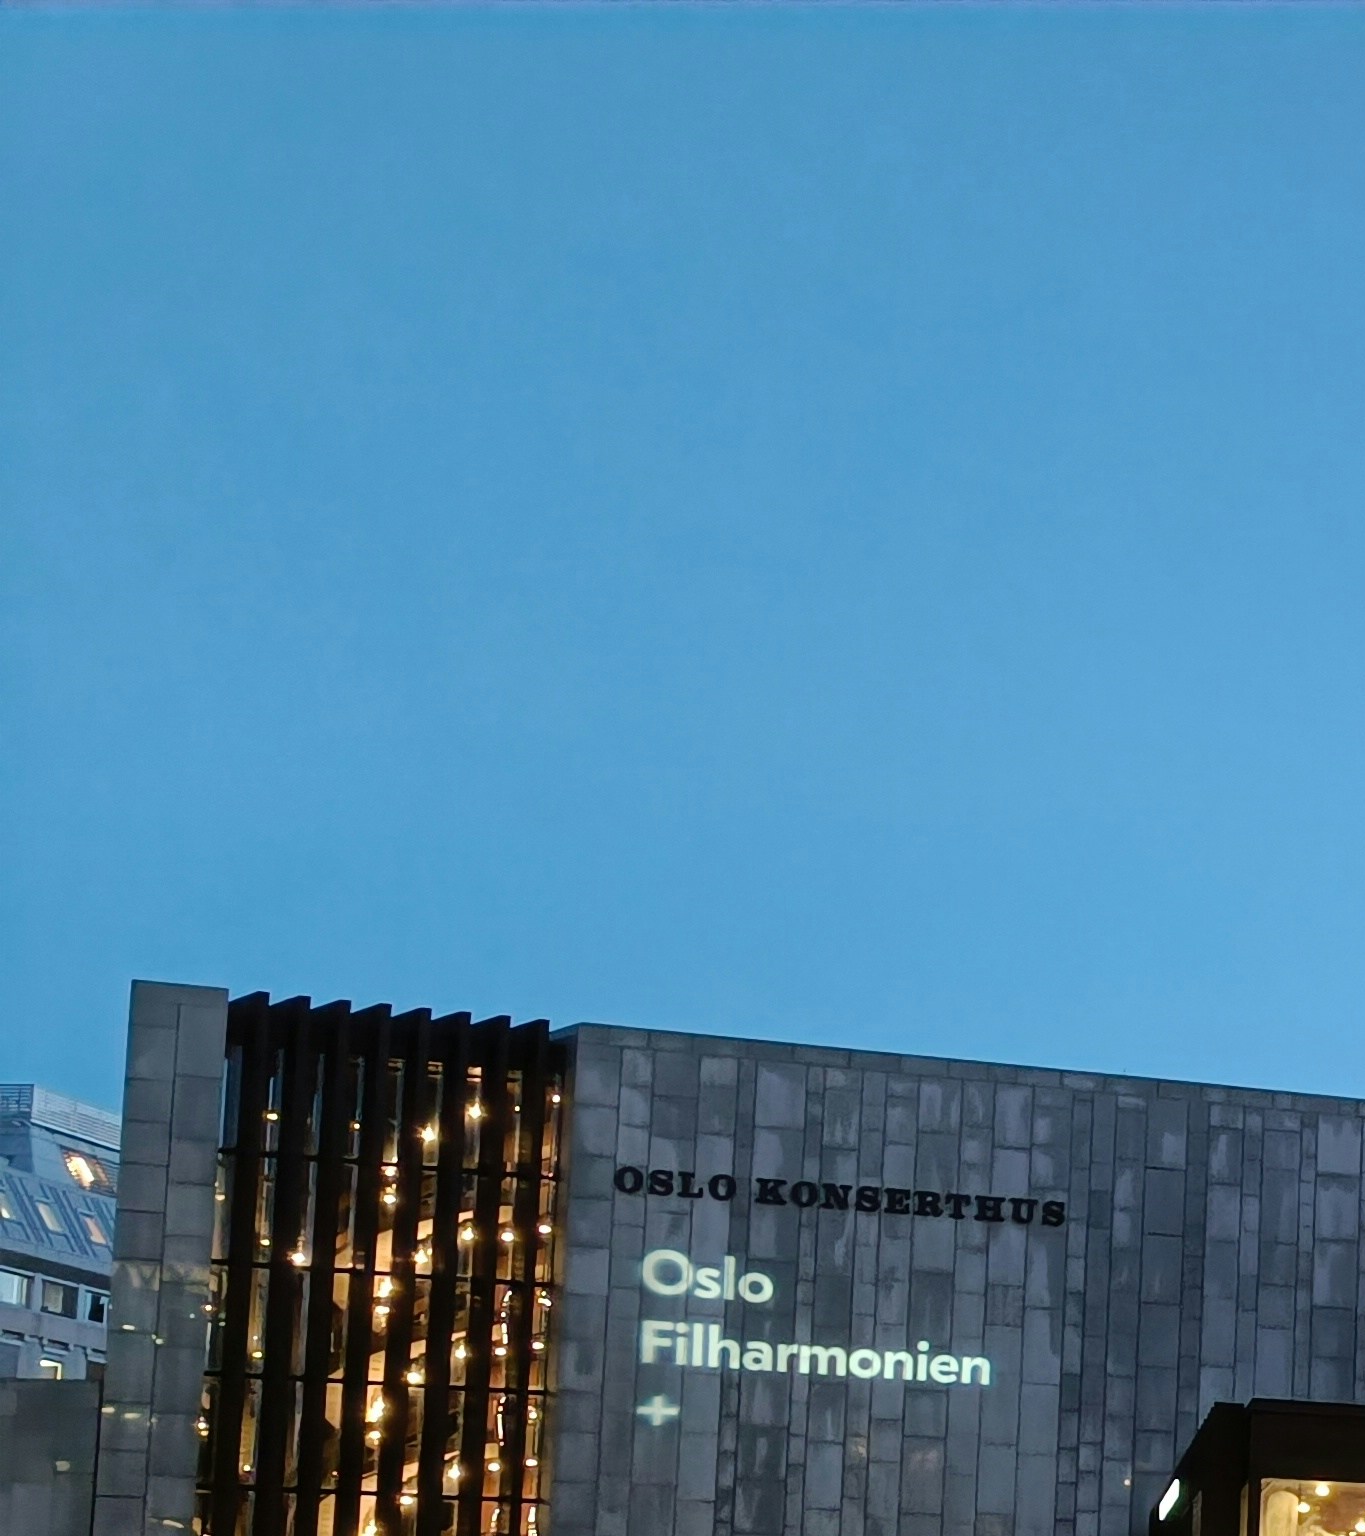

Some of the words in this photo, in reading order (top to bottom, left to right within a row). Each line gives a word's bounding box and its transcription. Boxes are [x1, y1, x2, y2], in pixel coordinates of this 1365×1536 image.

[613, 1166, 738, 1201] OSLO
[754, 1177, 1067, 1227] KONSERTHUS
[641, 1249, 775, 1304] Oslo
[640, 1319, 992, 1386] Filharmonien
